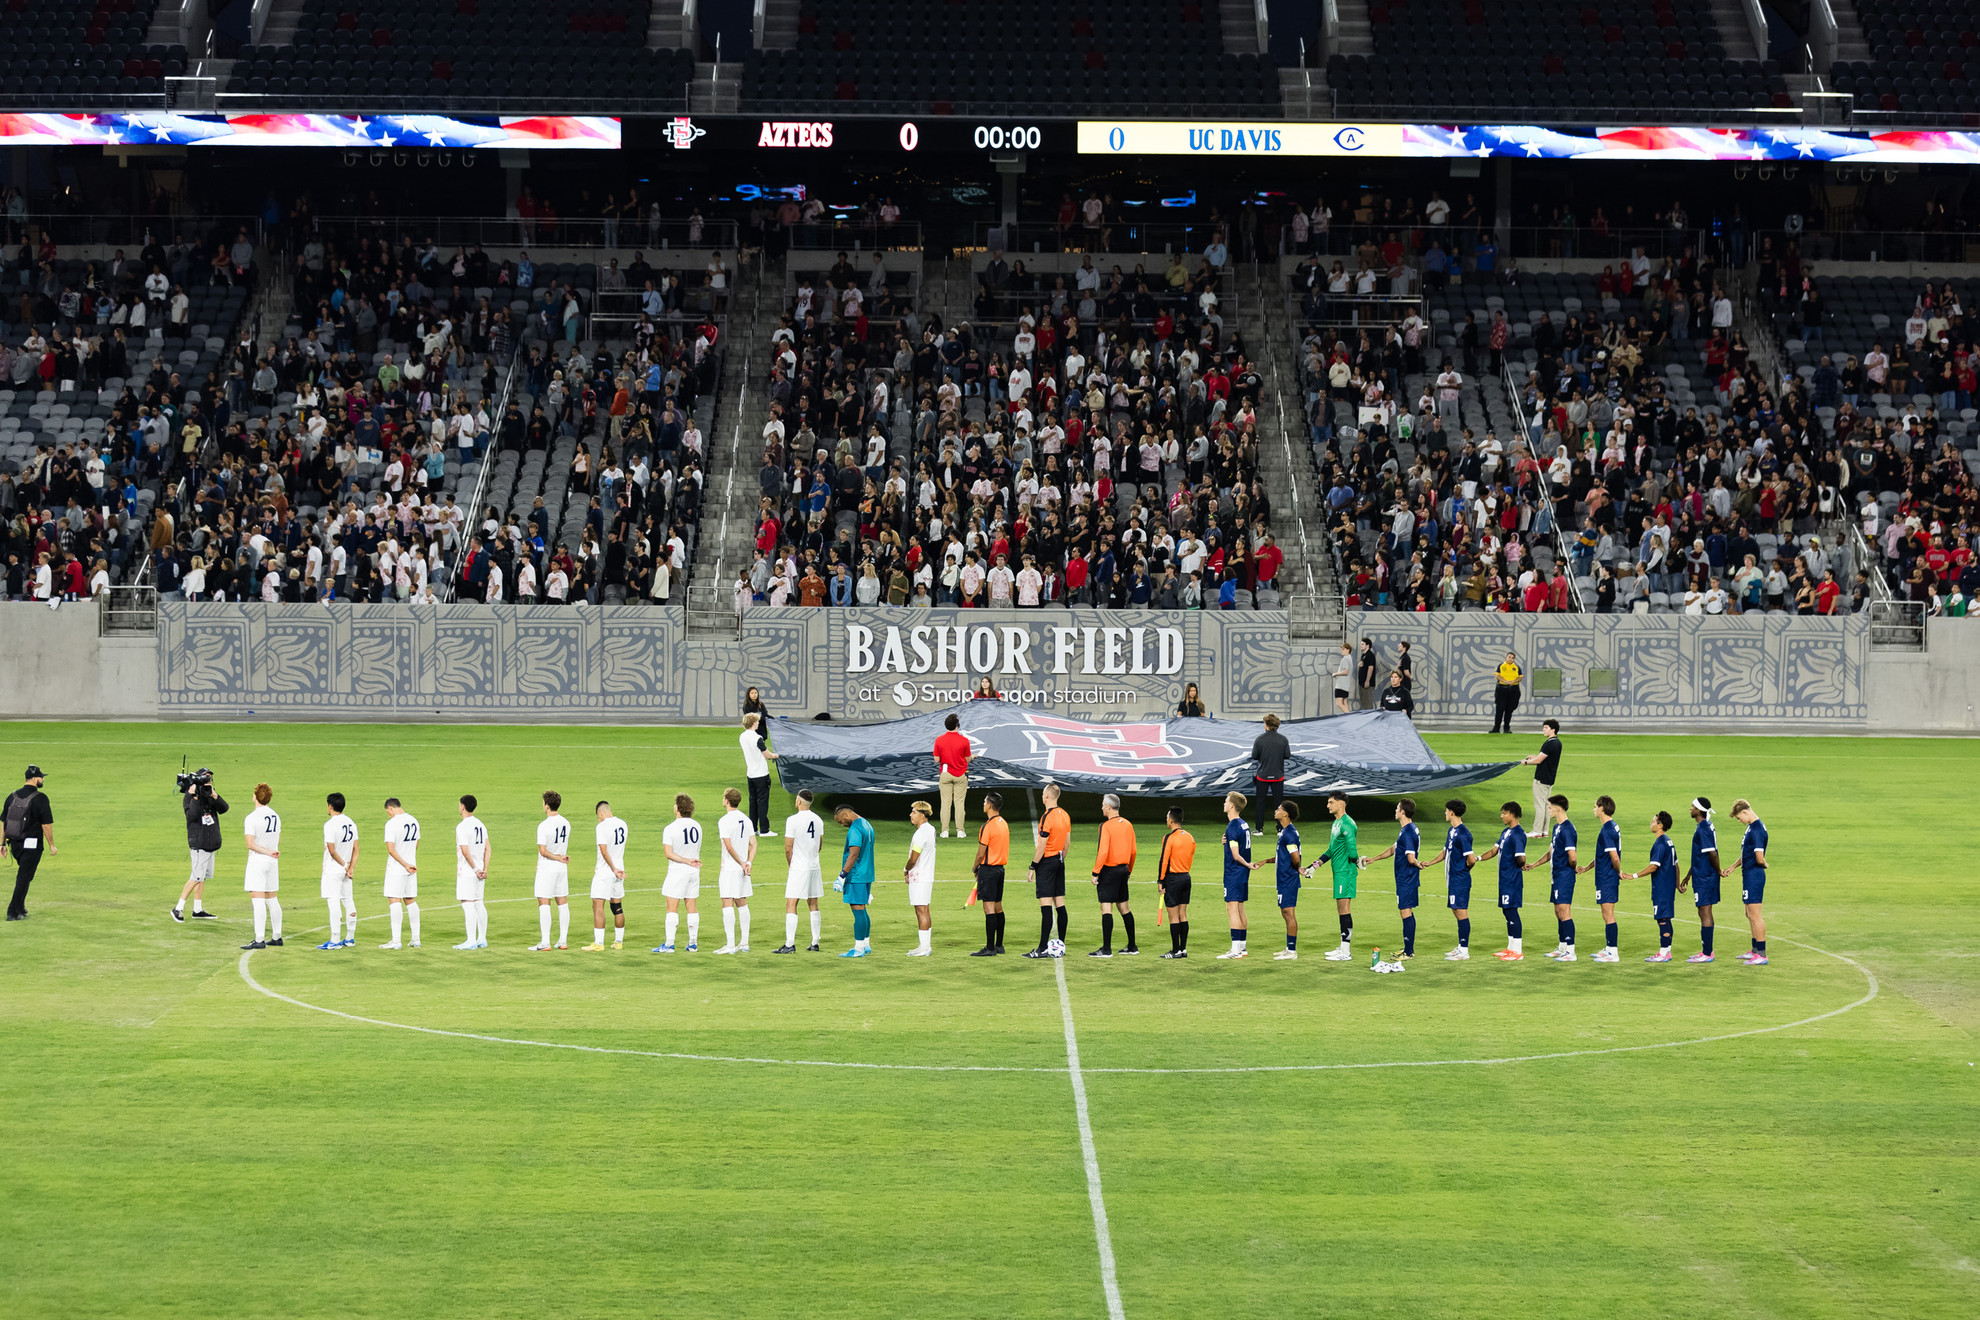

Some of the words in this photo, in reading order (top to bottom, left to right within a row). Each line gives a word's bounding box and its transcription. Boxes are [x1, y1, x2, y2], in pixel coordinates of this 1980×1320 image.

[758, 122, 833, 147] AZTECS
[900, 122, 918, 151] 0
[974, 126, 1041, 149] 00:00
[1109, 127, 1124, 151] 0
[1189, 129, 1214, 150] UC
[1220, 129, 1281, 151] DAVIS
[845, 625, 1033, 674] BASHOR
[1051, 627, 1185, 675] FIELD
[859, 685, 881, 702] at
[921, 684, 1048, 706] Snapagon
[1053, 685, 1137, 703] stadium
[264, 815, 277, 832] 27
[403, 823, 417, 841] 22
[738, 820, 744, 838] 7
[807, 821, 815, 838] 4
[341, 824, 353, 842] 25
[474, 826, 483, 844] 21
[554, 825, 567, 843] 14
[614, 827, 625, 845] 13
[683, 826, 699, 844] 10
[1501, 894, 1510, 904] 12
